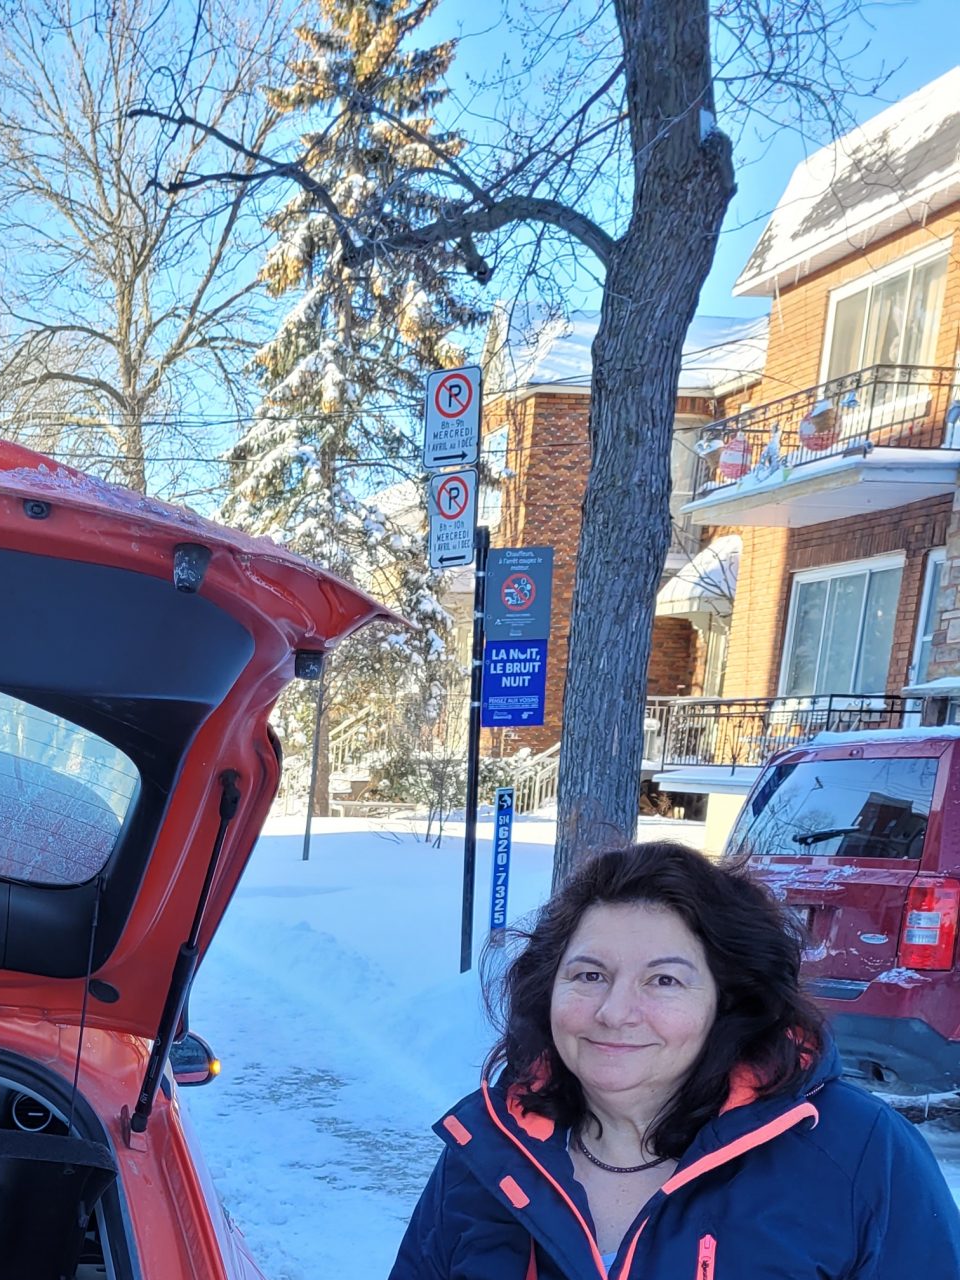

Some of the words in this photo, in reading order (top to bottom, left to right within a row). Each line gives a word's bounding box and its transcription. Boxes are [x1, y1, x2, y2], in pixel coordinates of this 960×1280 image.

[433, 427, 473, 440] MERCREDI
[437, 530, 470, 542] MERCREDI
[492, 649, 507, 660] LA
[490, 663, 504, 674] LE
[505, 662, 541, 673] BRUIT
[501, 676, 531, 687] NUIT
[499, 815, 510, 825] 514
